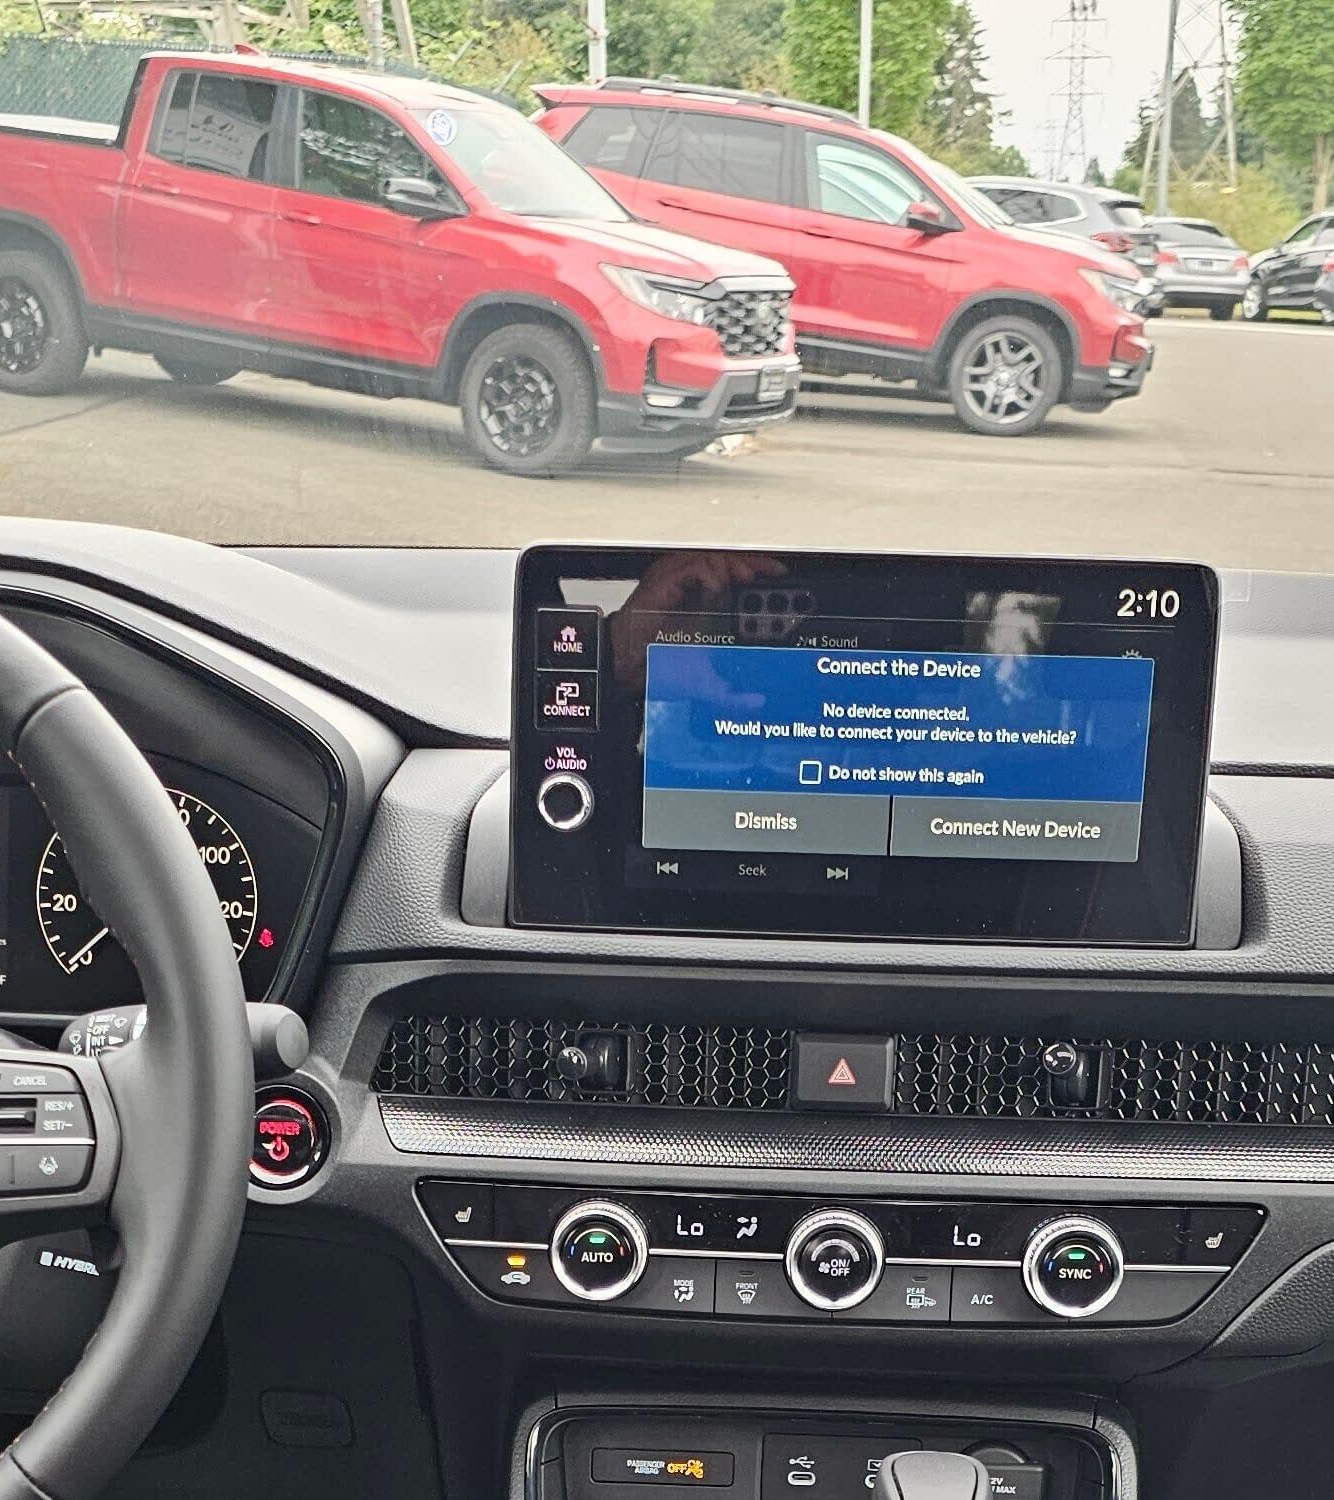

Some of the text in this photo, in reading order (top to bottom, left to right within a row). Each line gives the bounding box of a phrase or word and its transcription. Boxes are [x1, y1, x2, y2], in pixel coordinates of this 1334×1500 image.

[1117, 588, 1180, 618] 2:10
[655, 630, 735, 645] Audio Source
[821, 636, 858, 648] Sound
[553, 641, 583, 653] HOME
[817, 657, 981, 678] Connect the Device
[543, 705, 591, 717] CONNECT
[823, 703, 970, 721] No device connected.
[715, 721, 1077, 745] Would you like to connect your device to the vehicle?
[556, 747, 577, 758] VOL
[556, 759, 587, 771] AUDIO
[828, 765, 985, 786] Do not show this again
[735, 812, 797, 830] Dismiss
[930, 818, 1101, 839] Connect New Device
[738, 863, 767, 877] Seek
[52, 894, 77, 912] 20
[0, 974, 7, 985] F
[92, 1025, 110, 1035] OFF
[91, 1035, 106, 1047] INT
[13, 1076, 47, 1086] CANCEL
[259, 1121, 301, 1135] POWER
[581, 1252, 613, 1263] AUTO
[830, 1259, 851, 1268] ON/
[830, 1268, 851, 1277] OFF
[1058, 1268, 1092, 1279] SYNC
[673, 1279, 694, 1287] MODE
[970, 1294, 994, 1305] A/C
[667, 1463, 687, 1473] OFF
[995, 1486, 1016, 1494] MAX
